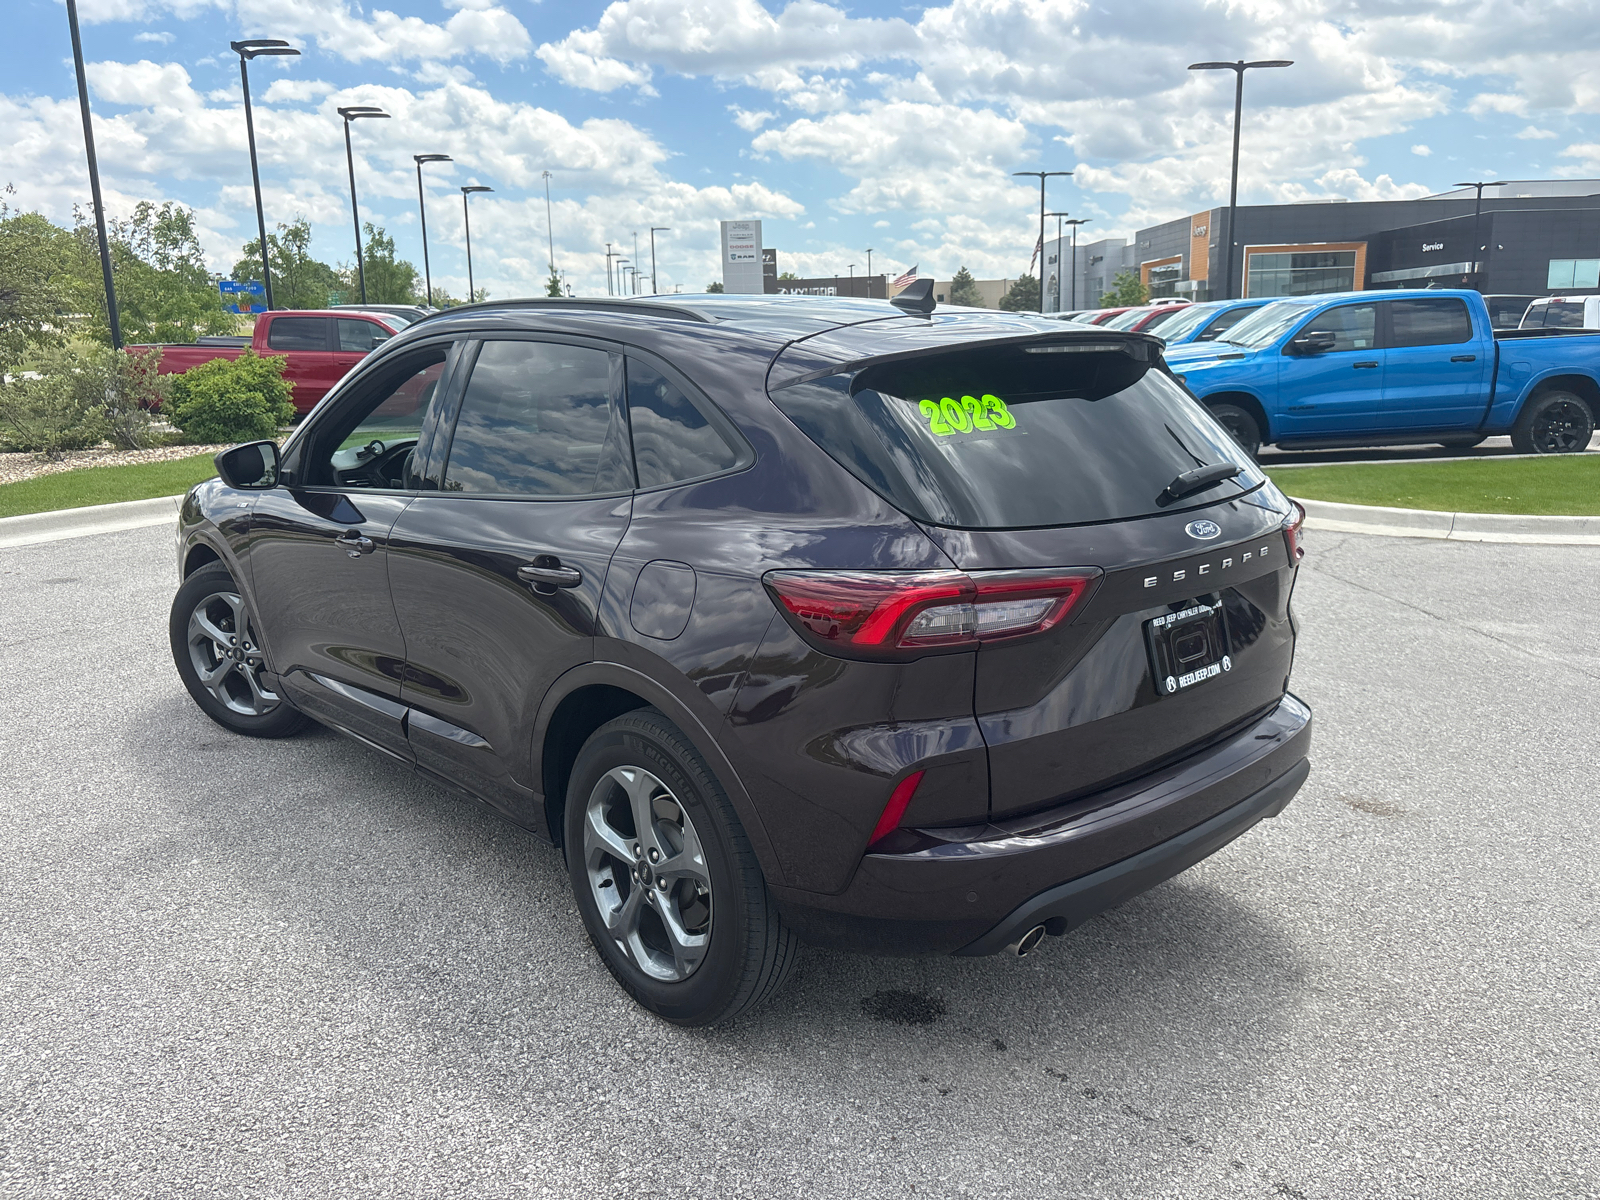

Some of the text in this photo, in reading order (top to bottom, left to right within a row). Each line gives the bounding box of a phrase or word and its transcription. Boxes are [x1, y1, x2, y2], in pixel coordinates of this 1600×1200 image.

[1193, 225, 1207, 237] Jeep
[1422, 242, 1444, 252] Service
[918, 393, 1017, 437] 2023
[1194, 522, 1216, 535] Ford
[1143, 546, 1269, 588] ESCAPE
[1152, 616, 1166, 628] REED
[1166, 613, 1177, 624] JEEP
[1177, 606, 1199, 620] CHRYSLER
[1178, 663, 1221, 688] REEDJEEP.COM
[645, 746, 698, 801] MICHELIN
